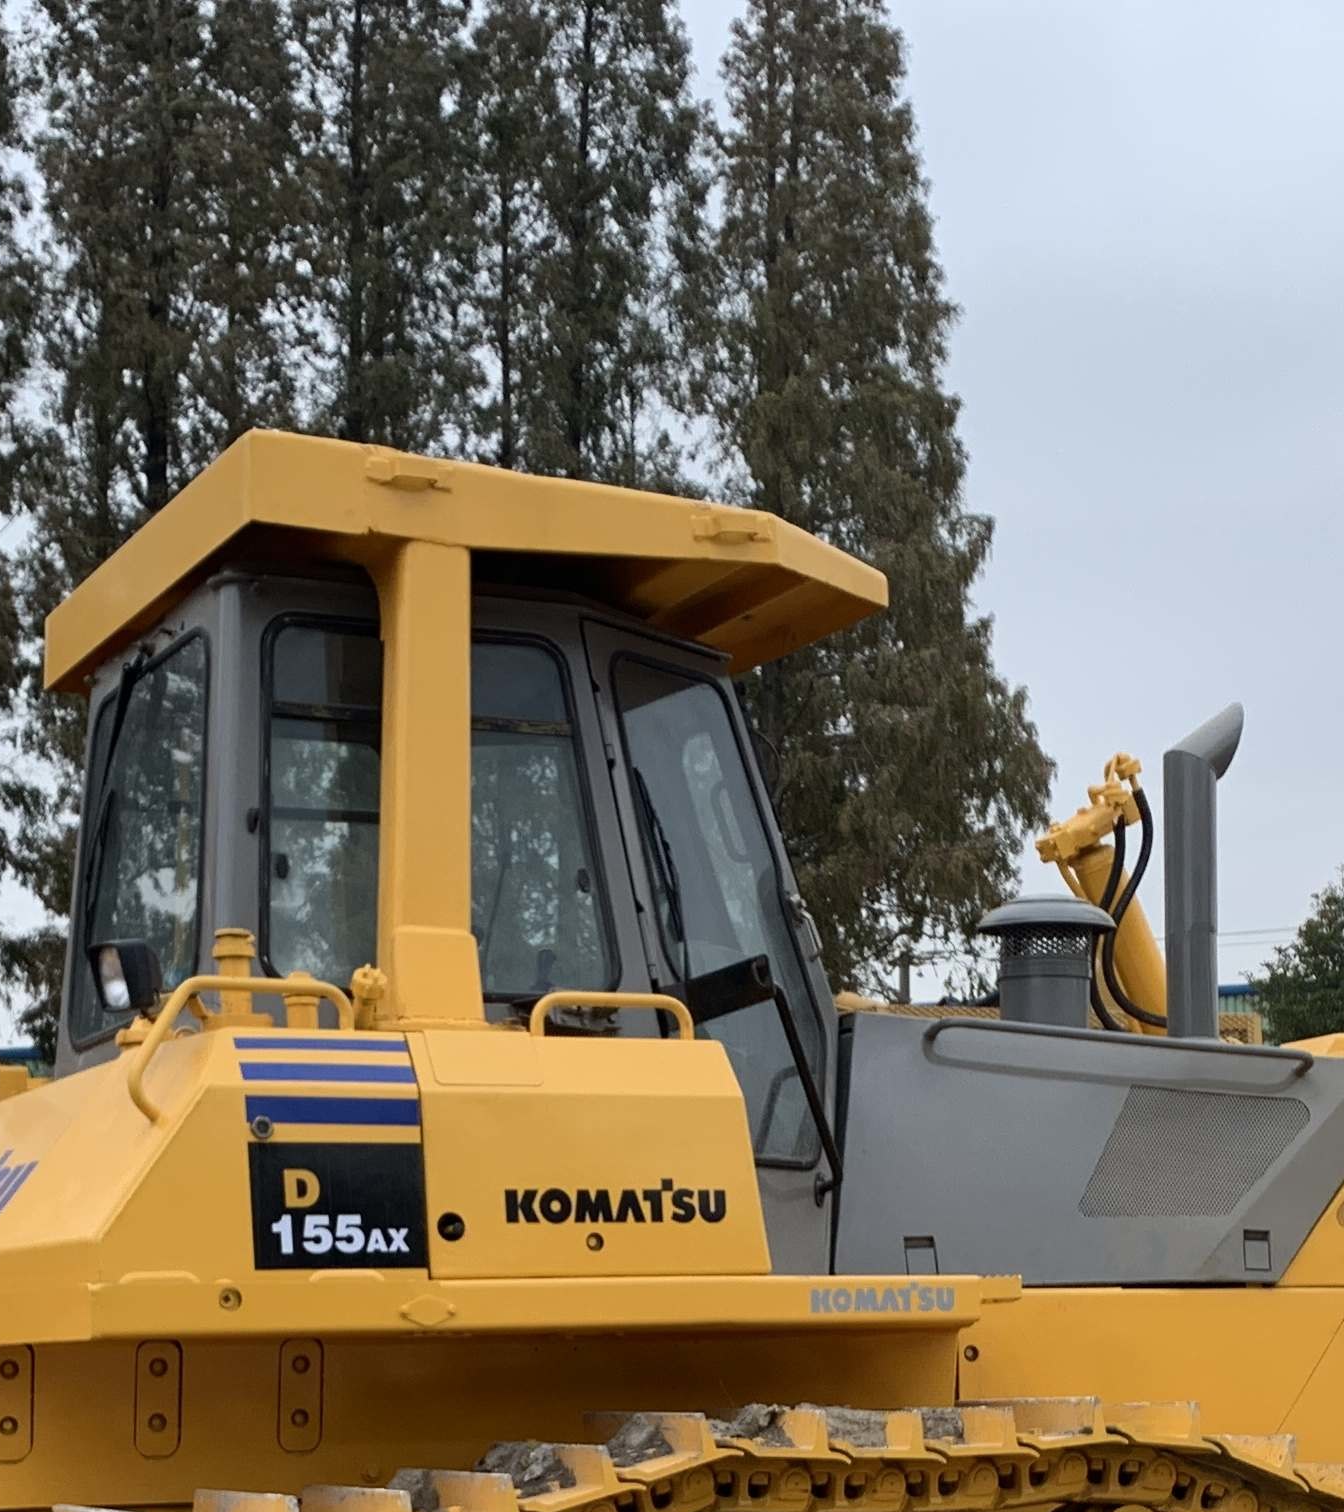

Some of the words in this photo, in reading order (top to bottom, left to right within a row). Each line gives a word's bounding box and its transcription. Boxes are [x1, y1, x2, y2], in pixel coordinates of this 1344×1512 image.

[282, 1168, 321, 1209] D
[504, 1178, 727, 1224] KOMATSU
[271, 1214, 411, 1255] 155AX
[810, 1282, 955, 1314] KOMATSU
